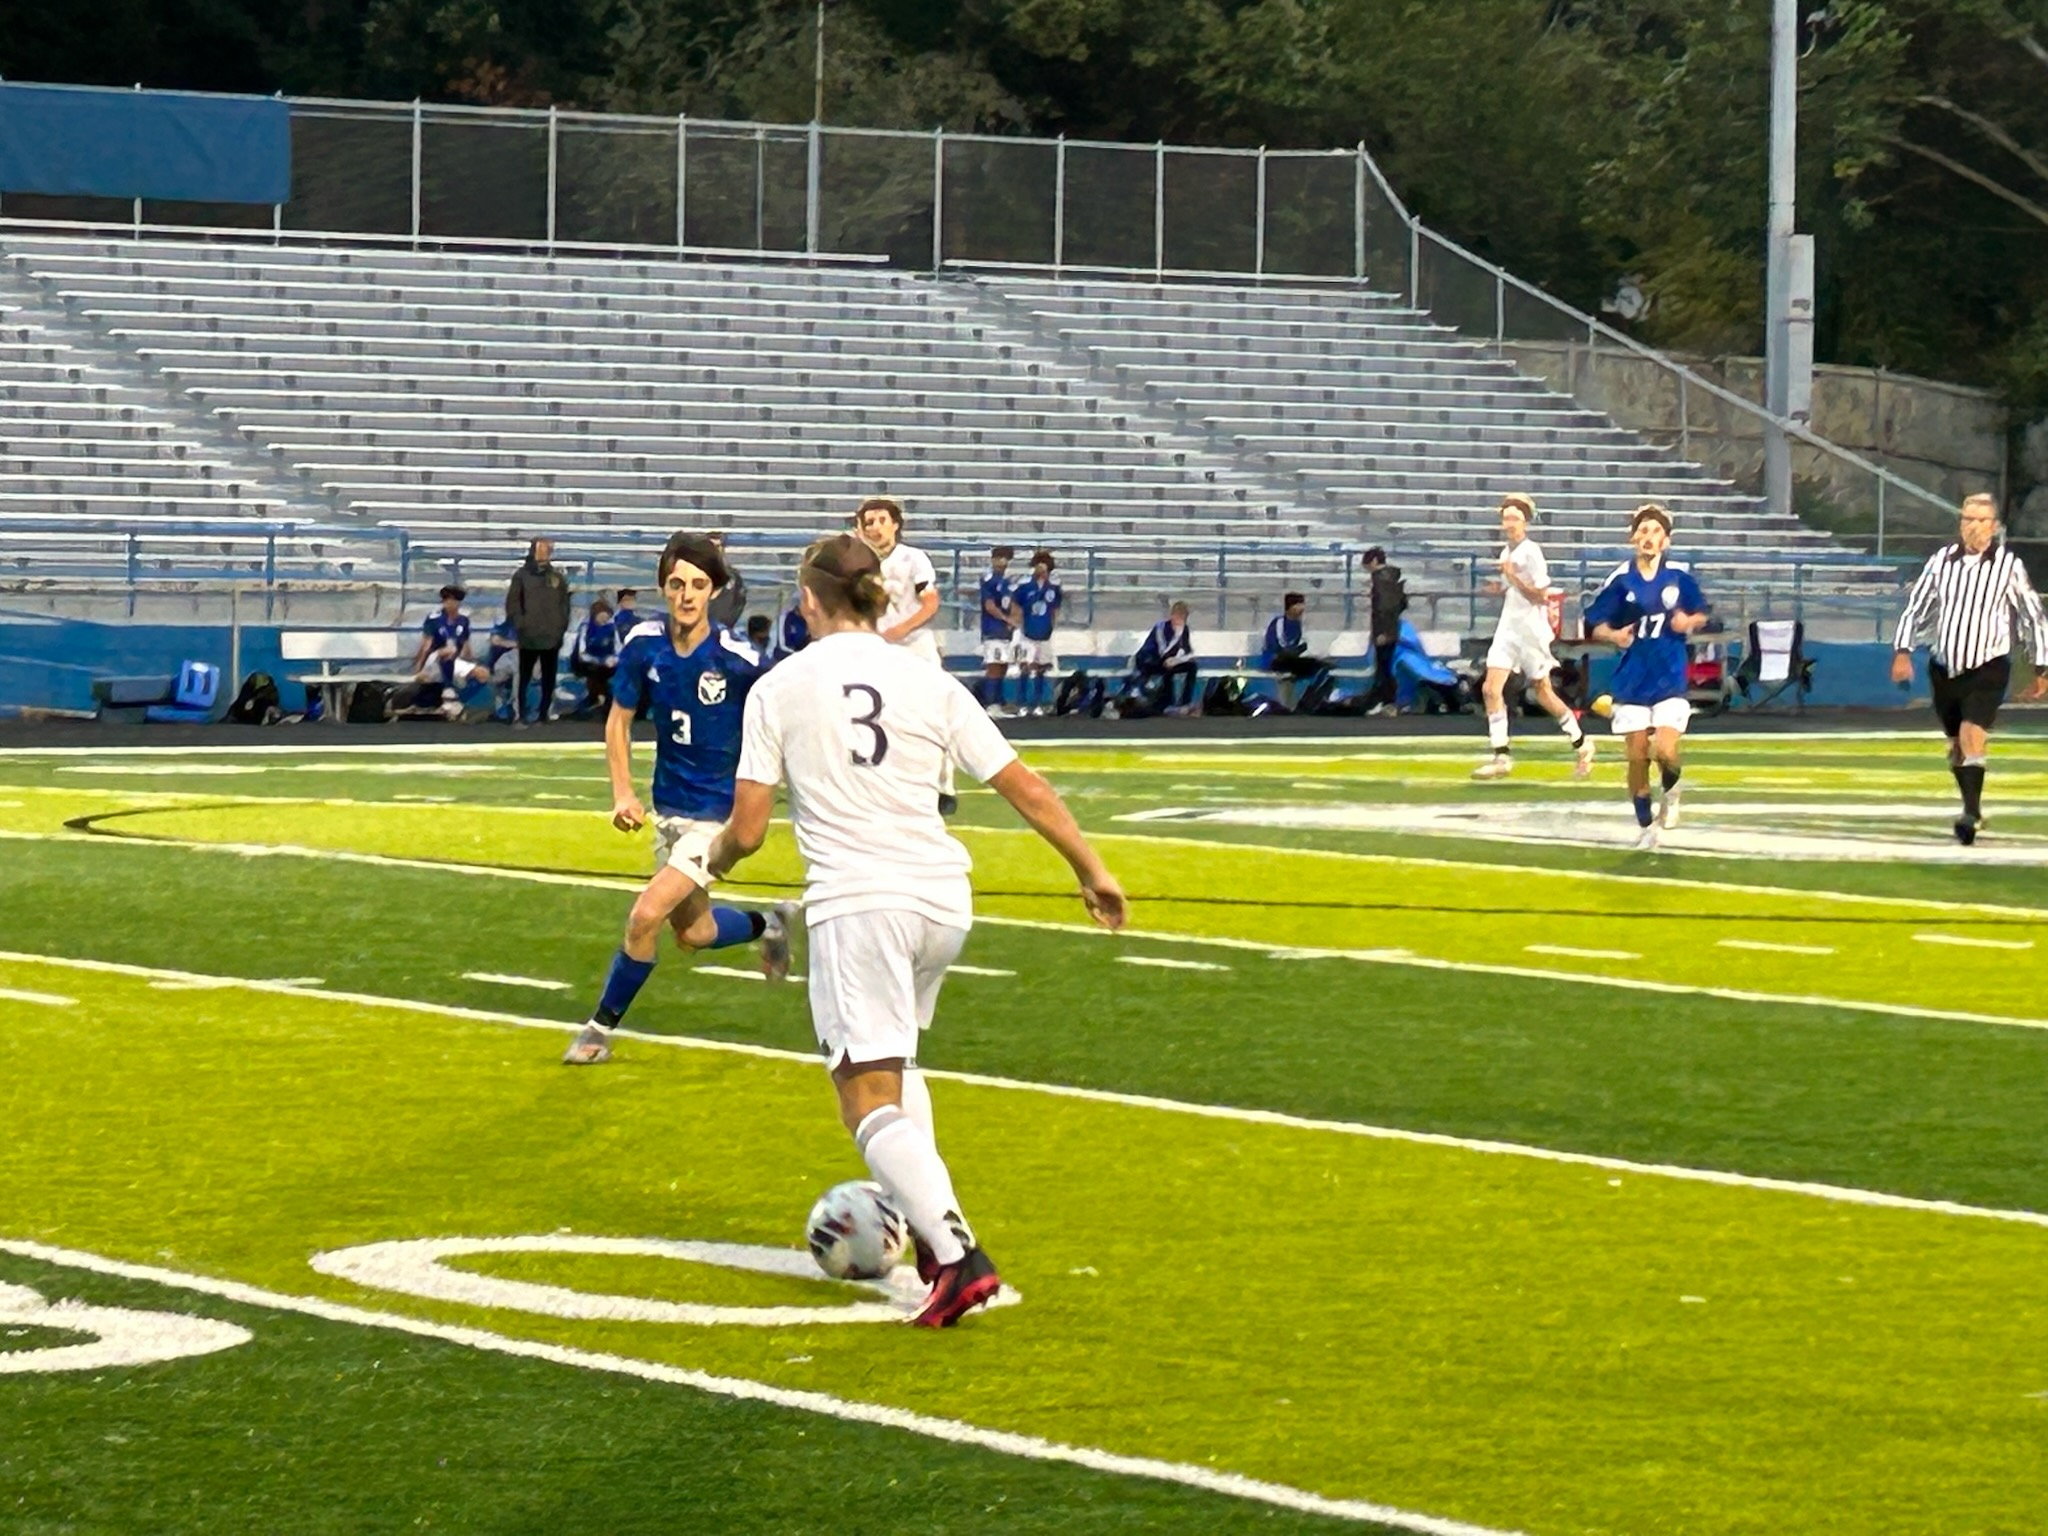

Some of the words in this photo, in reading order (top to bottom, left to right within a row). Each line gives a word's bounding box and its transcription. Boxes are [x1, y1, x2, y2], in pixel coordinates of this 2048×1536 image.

[1637, 612, 1666, 639] 17
[671, 709, 692, 745] 3
[842, 683, 889, 768] 3
